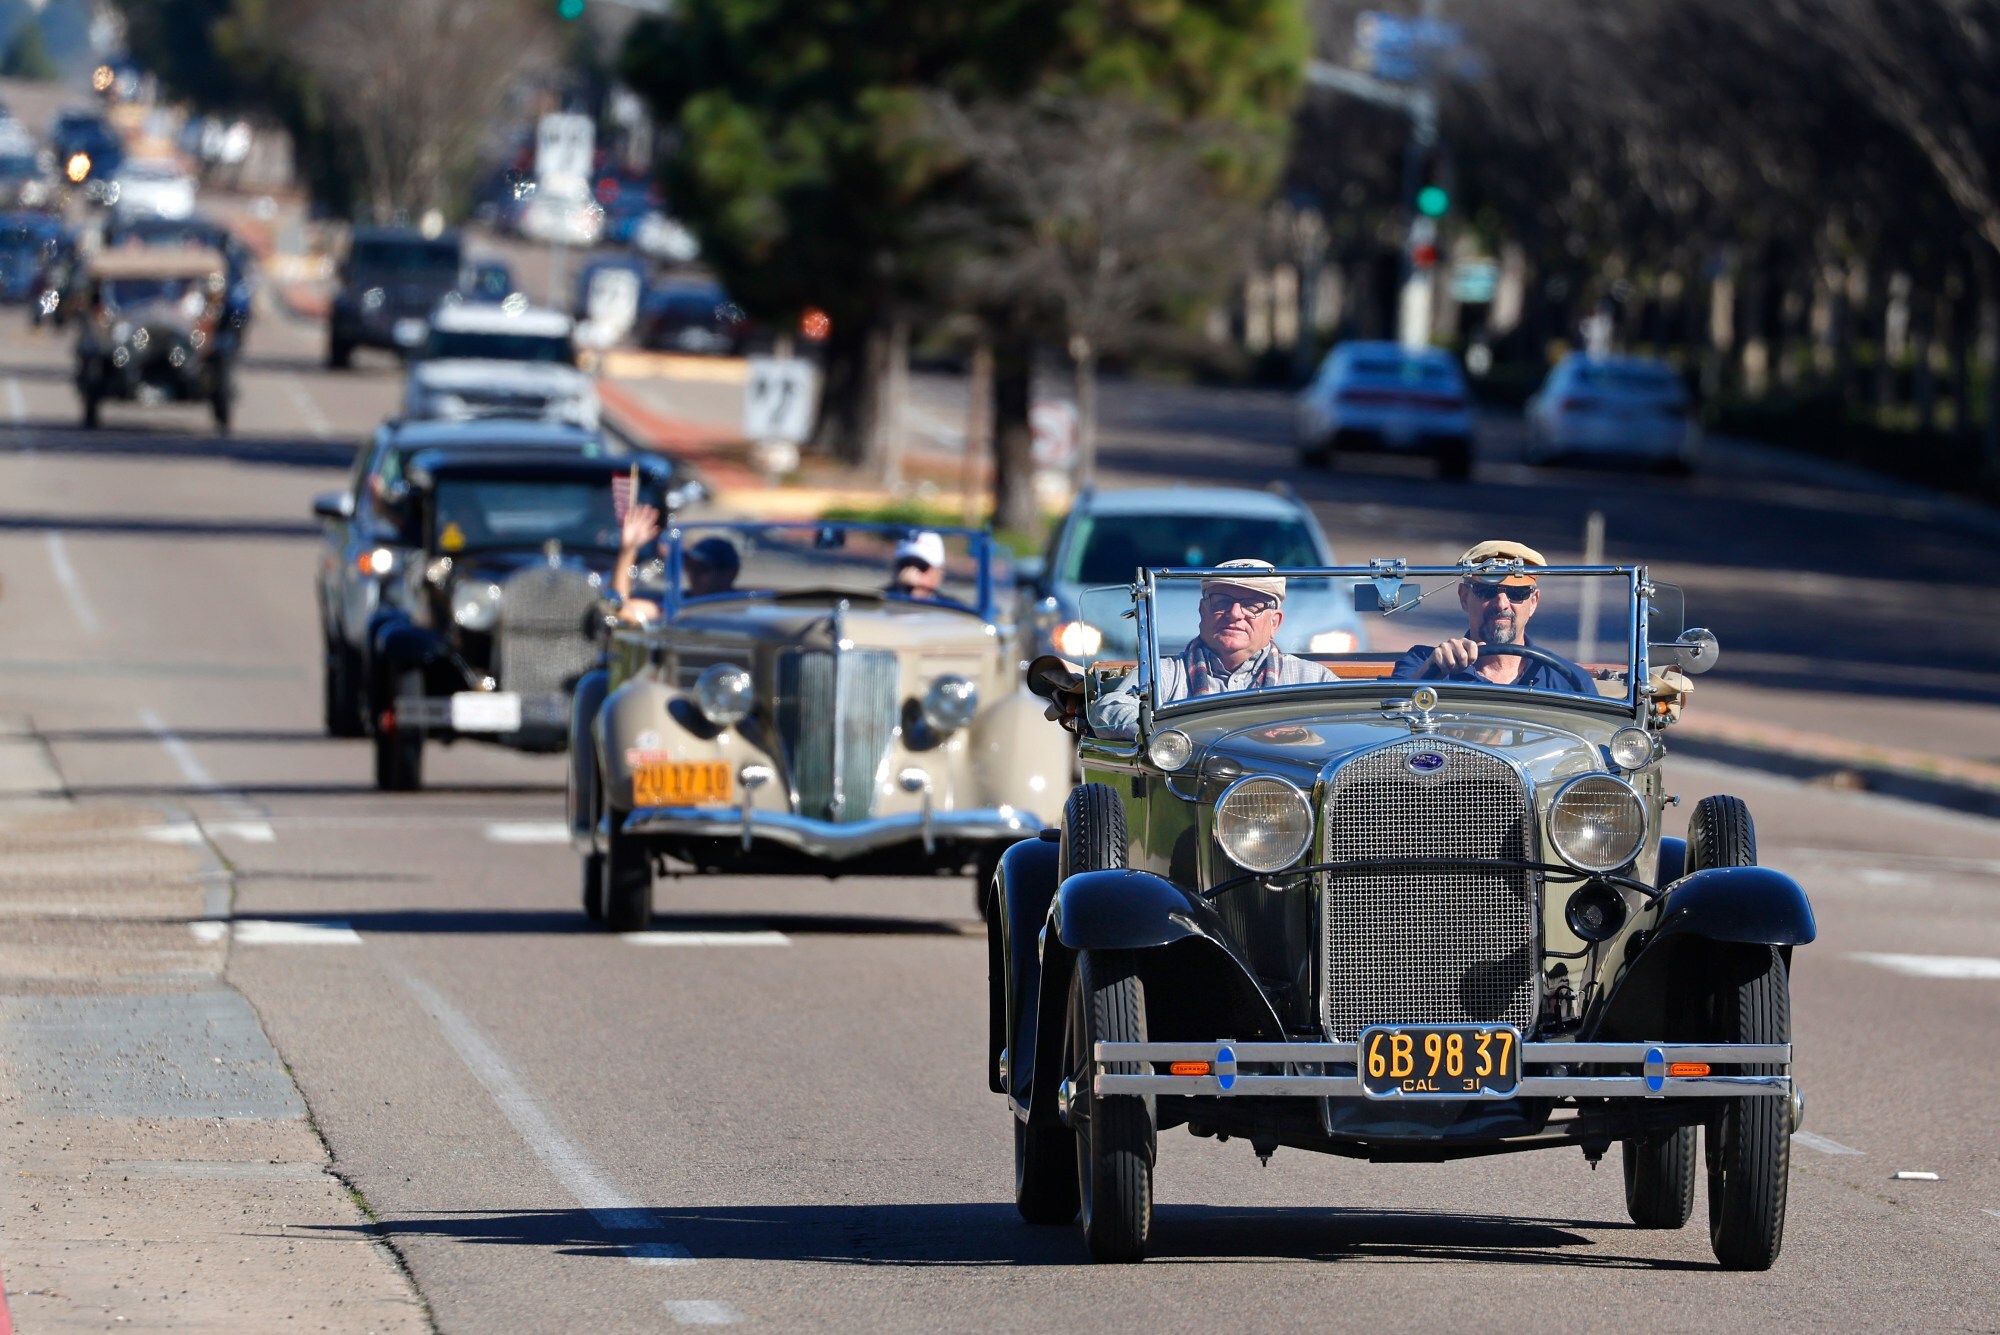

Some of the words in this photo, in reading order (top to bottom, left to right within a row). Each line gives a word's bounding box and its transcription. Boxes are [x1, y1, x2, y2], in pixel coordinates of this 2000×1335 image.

[1368, 1034, 1414, 1077] 6B
[1424, 1033, 1464, 1077] 98
[1474, 1033, 1513, 1077] 37
[1402, 1079, 1440, 1091] CAL
[1463, 1078, 1480, 1090] 31
